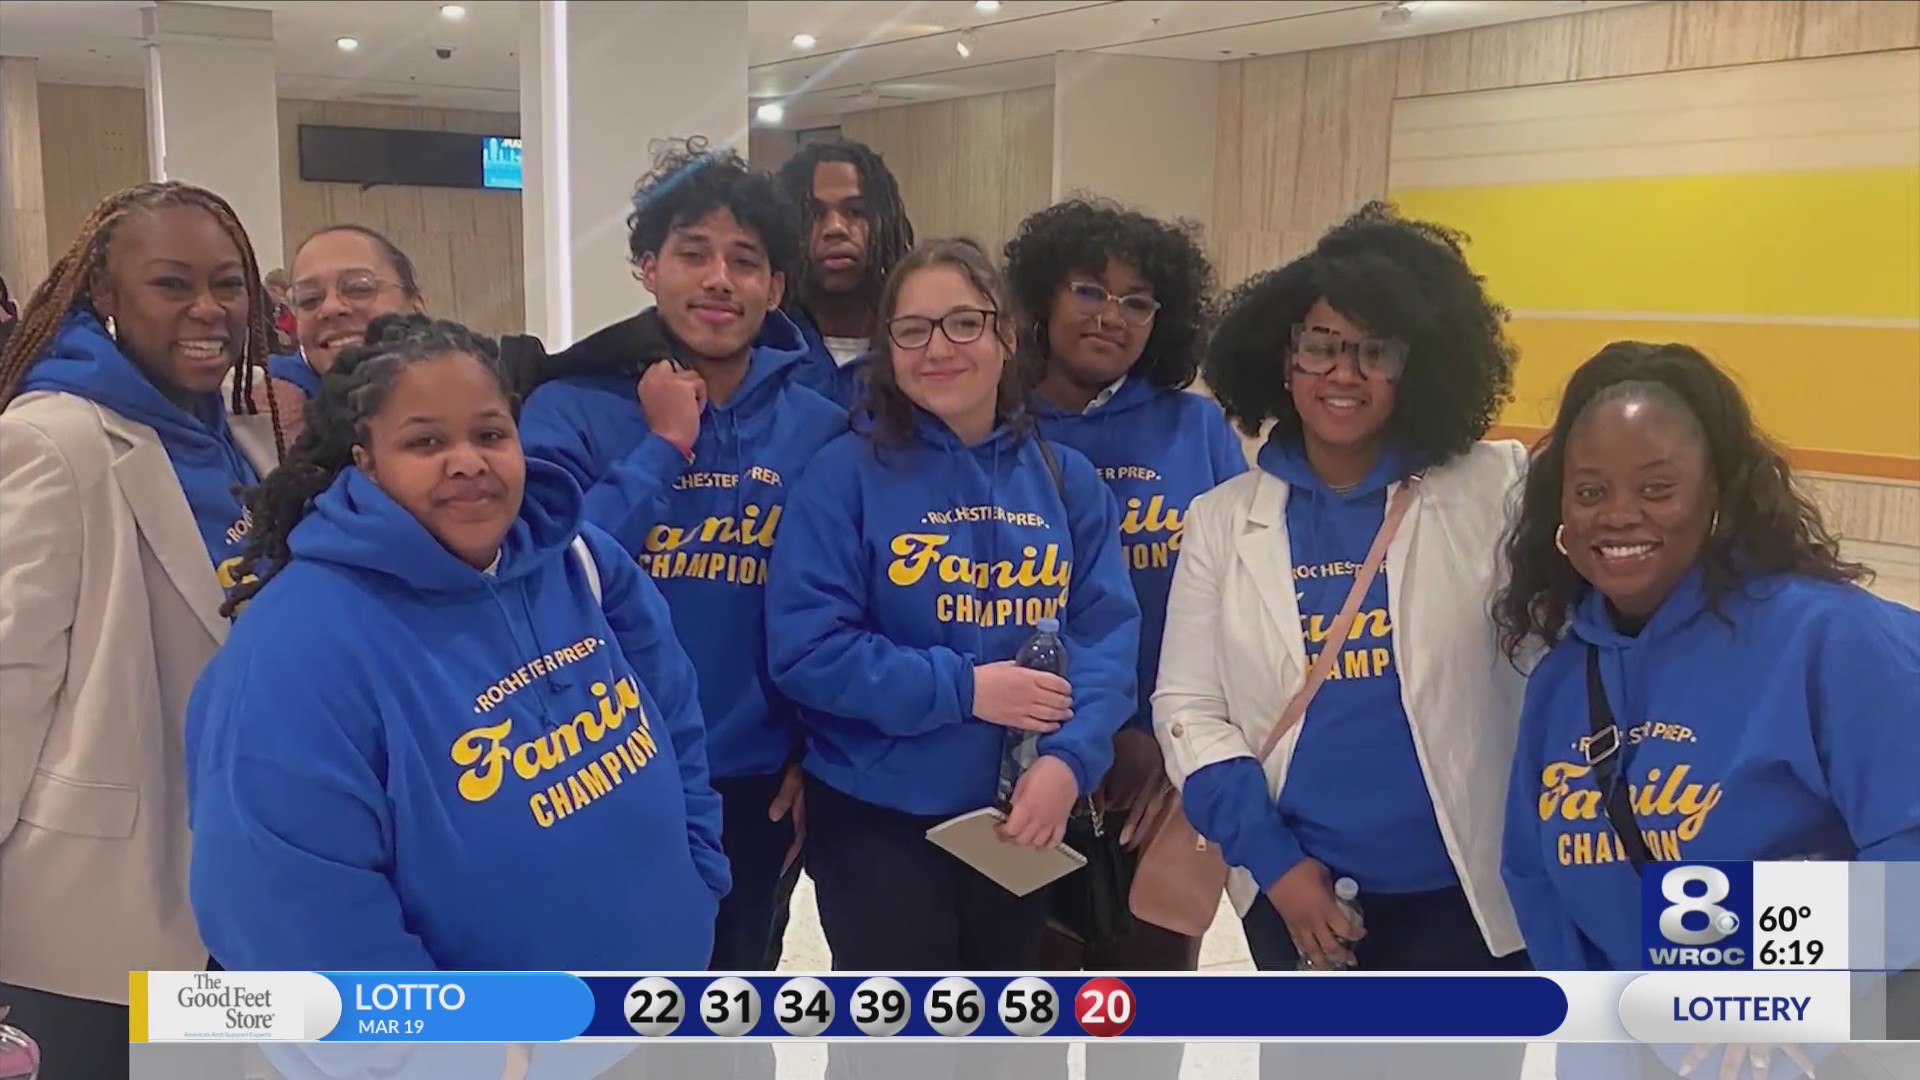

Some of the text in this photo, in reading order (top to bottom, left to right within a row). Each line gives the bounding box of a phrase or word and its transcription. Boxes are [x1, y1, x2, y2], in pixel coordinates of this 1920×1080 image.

[744, 466, 780, 485] REP
[1118, 466, 1156, 480] PREP
[1008, 513, 1045, 528] PREP
[1119, 494, 1184, 551] ily
[888, 532, 1073, 607] Family
[937, 594, 1058, 628] CHMPION
[476, 637, 598, 712] ROCHETER PREP
[530, 725, 657, 827] CHAMPION
[1538, 762, 1722, 841] Faily
